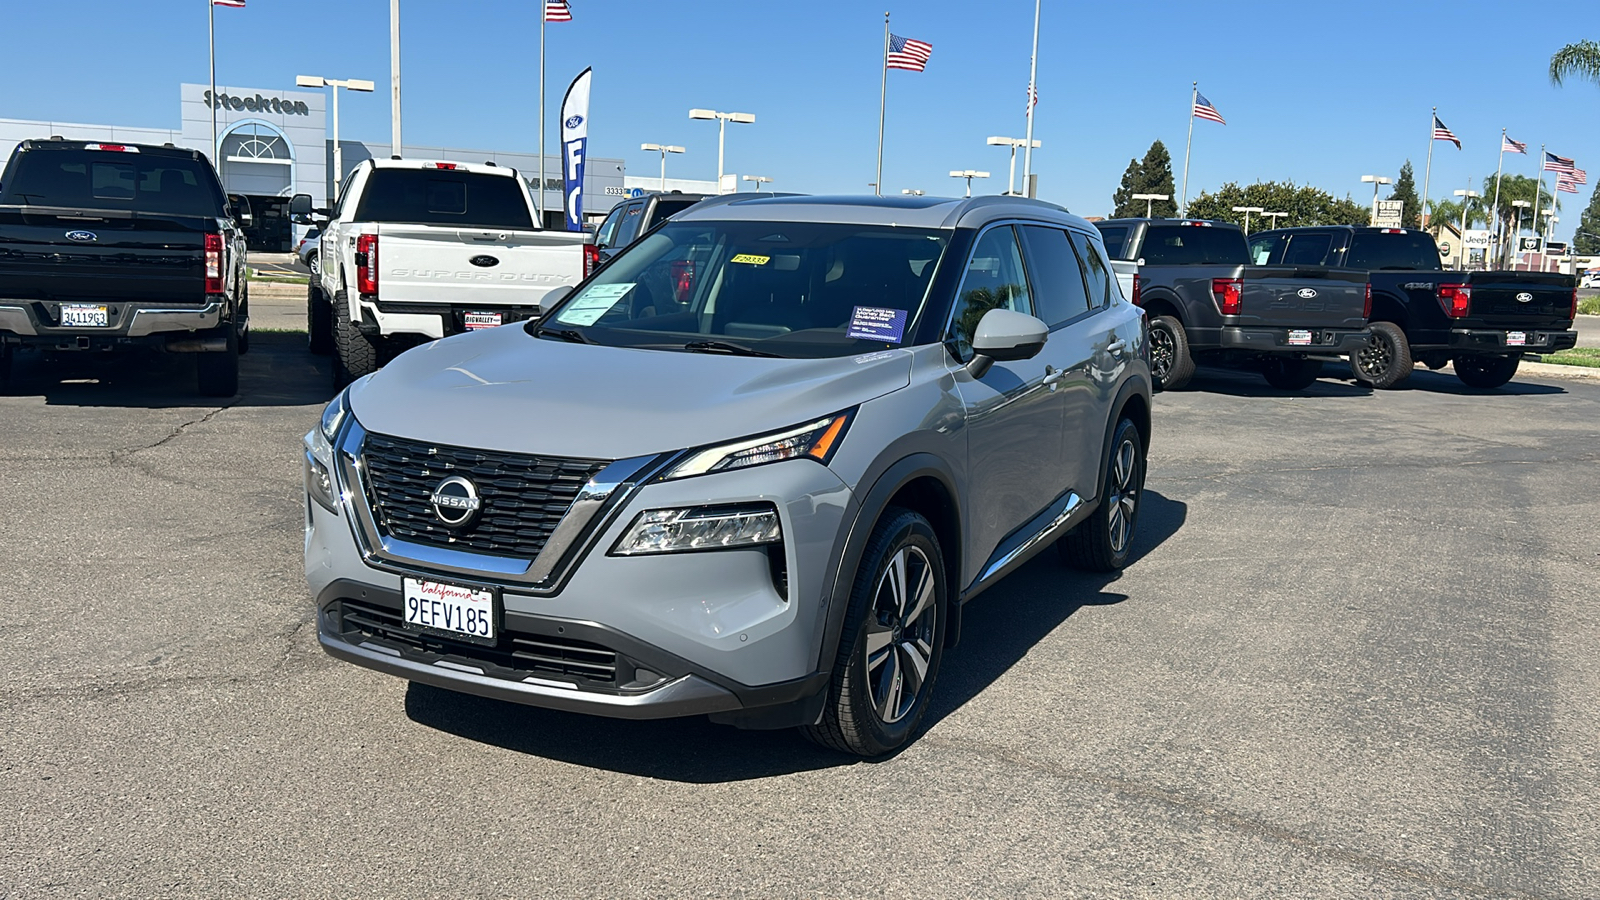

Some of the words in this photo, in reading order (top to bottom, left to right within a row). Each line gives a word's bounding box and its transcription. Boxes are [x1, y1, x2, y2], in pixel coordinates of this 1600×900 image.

[204, 90, 309, 116] Stockton
[606, 187, 624, 195] 3333
[1379, 202, 1401, 210] OEM
[1465, 236, 1487, 245] Jeep
[391, 268, 494, 281] SUPER
[499, 272, 574, 283] DUTY
[64, 312, 106, 324] 34119G3
[430, 494, 479, 510] NISSAN
[421, 581, 479, 602] California
[408, 596, 490, 636] 9EFV185
